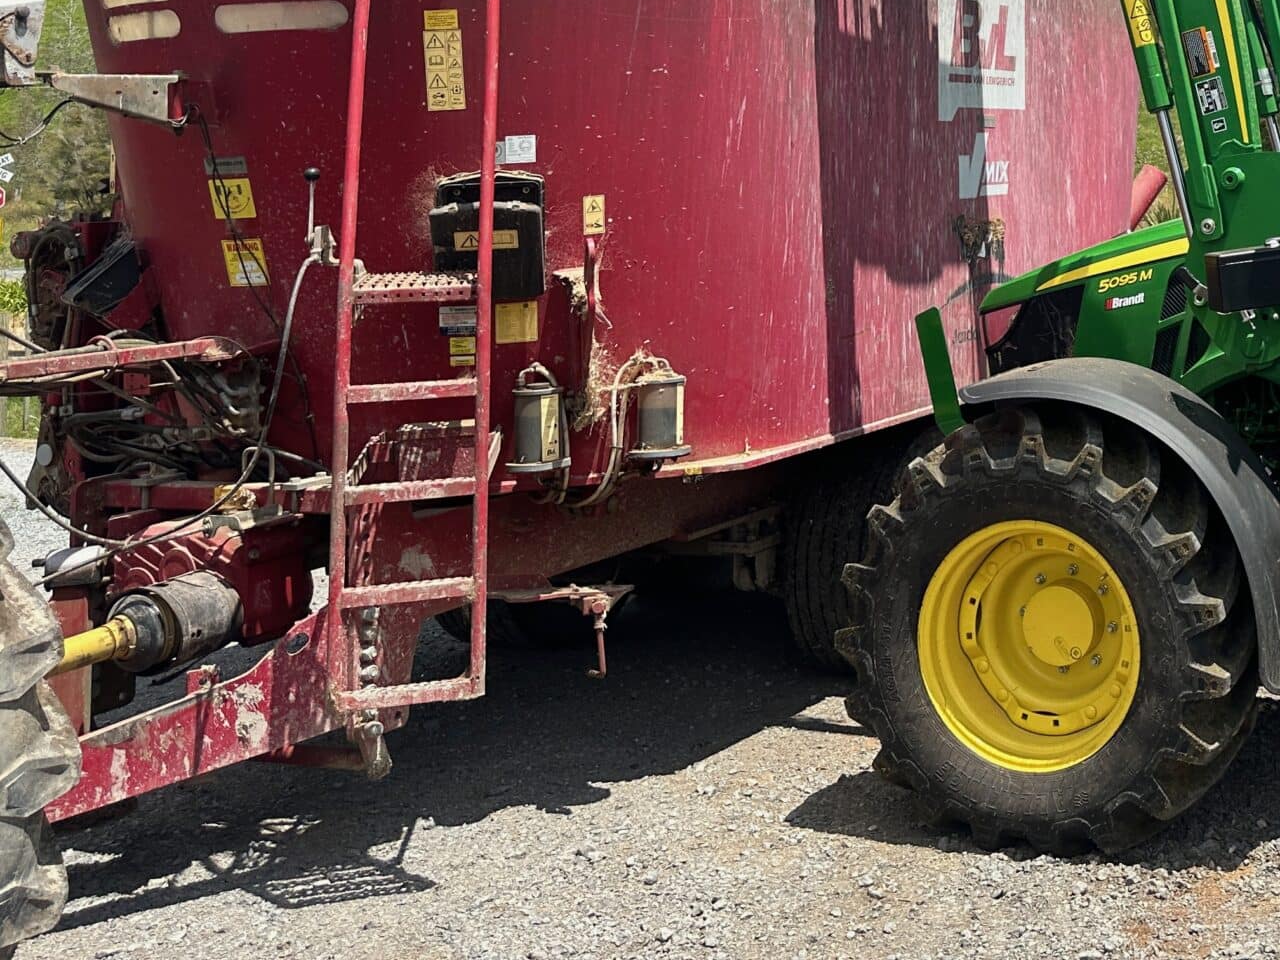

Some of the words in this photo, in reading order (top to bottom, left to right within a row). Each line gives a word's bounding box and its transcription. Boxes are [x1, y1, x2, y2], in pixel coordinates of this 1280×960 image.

[981, 160, 1010, 183] MIX
[1097, 271, 1138, 293] 5095
[1139, 268, 1153, 281] M
[1111, 292, 1145, 309] Brandt
